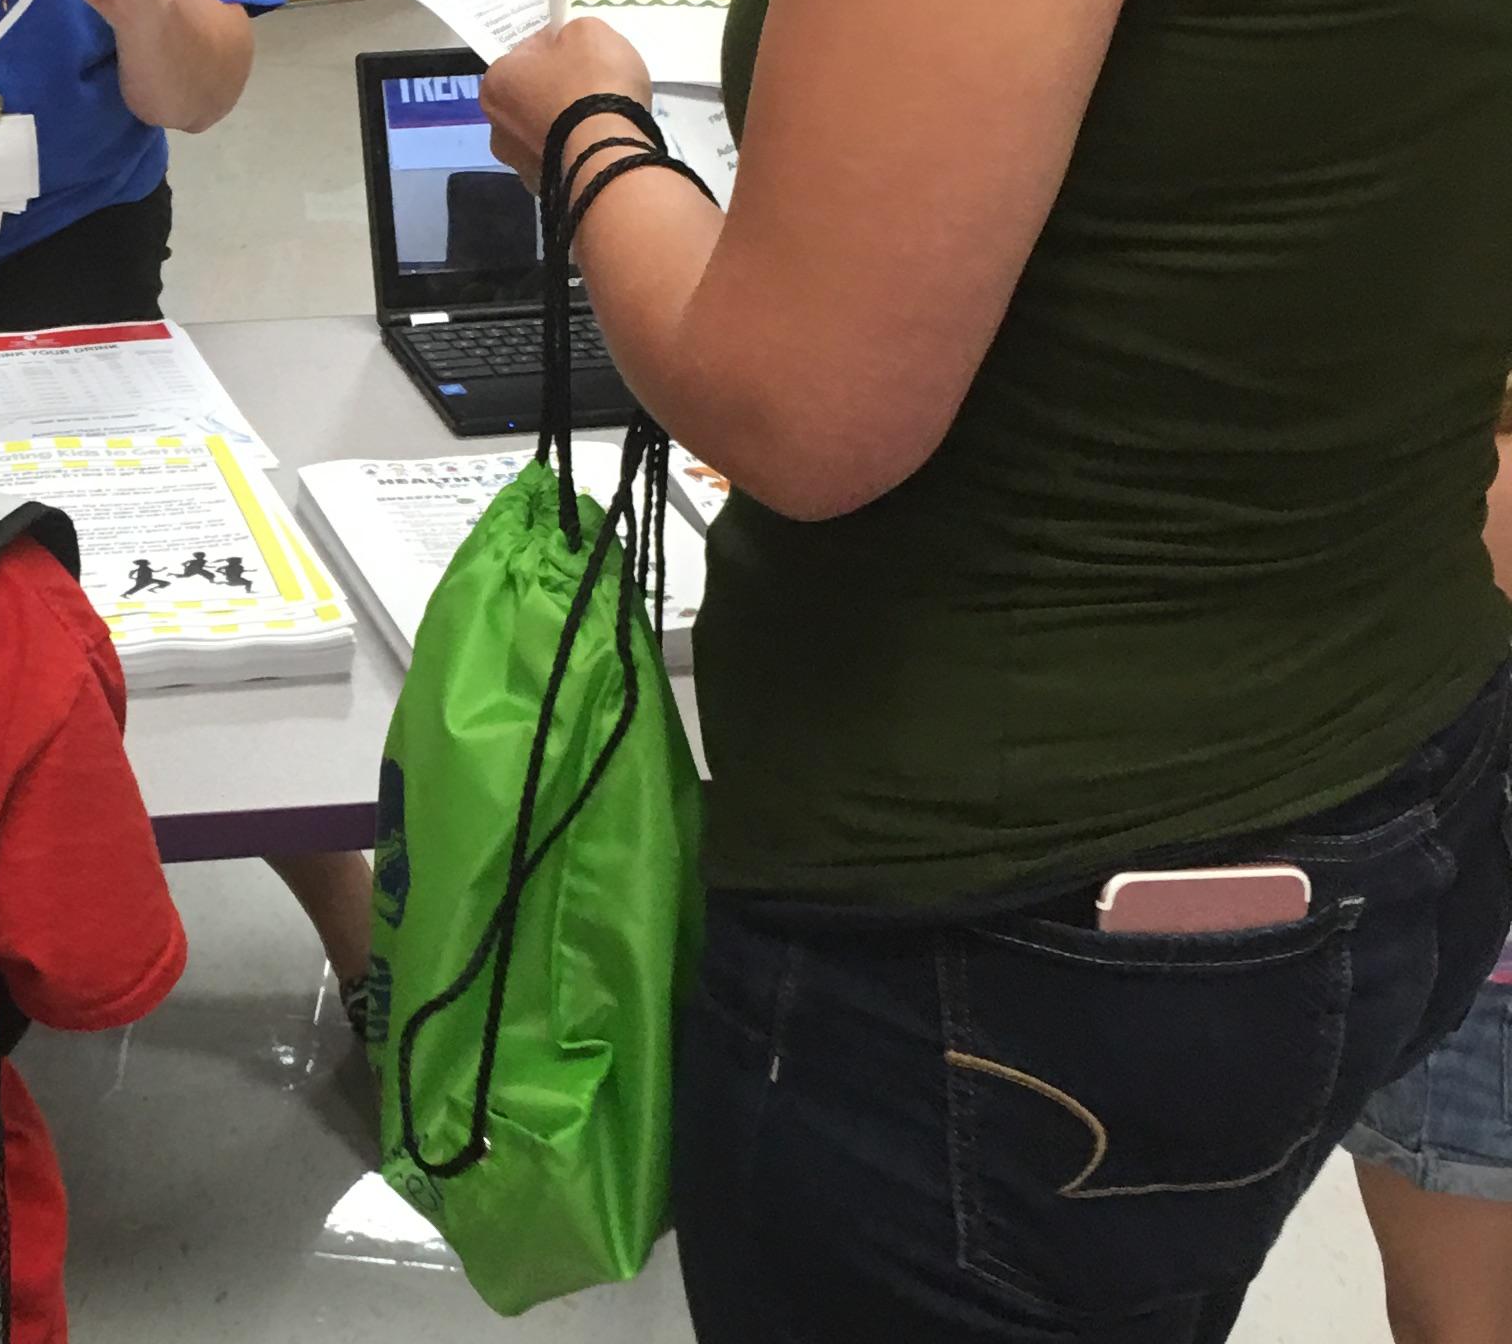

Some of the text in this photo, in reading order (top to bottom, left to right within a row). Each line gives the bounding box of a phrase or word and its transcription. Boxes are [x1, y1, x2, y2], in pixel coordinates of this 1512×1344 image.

[399, 73, 485, 103] TREN
[31, 348, 70, 357] YOUR
[74, 343, 119, 354] DRINK
[57, 447, 100, 458] Kids
[106, 446, 128, 457] to
[377, 474, 483, 485] HEALTHY
